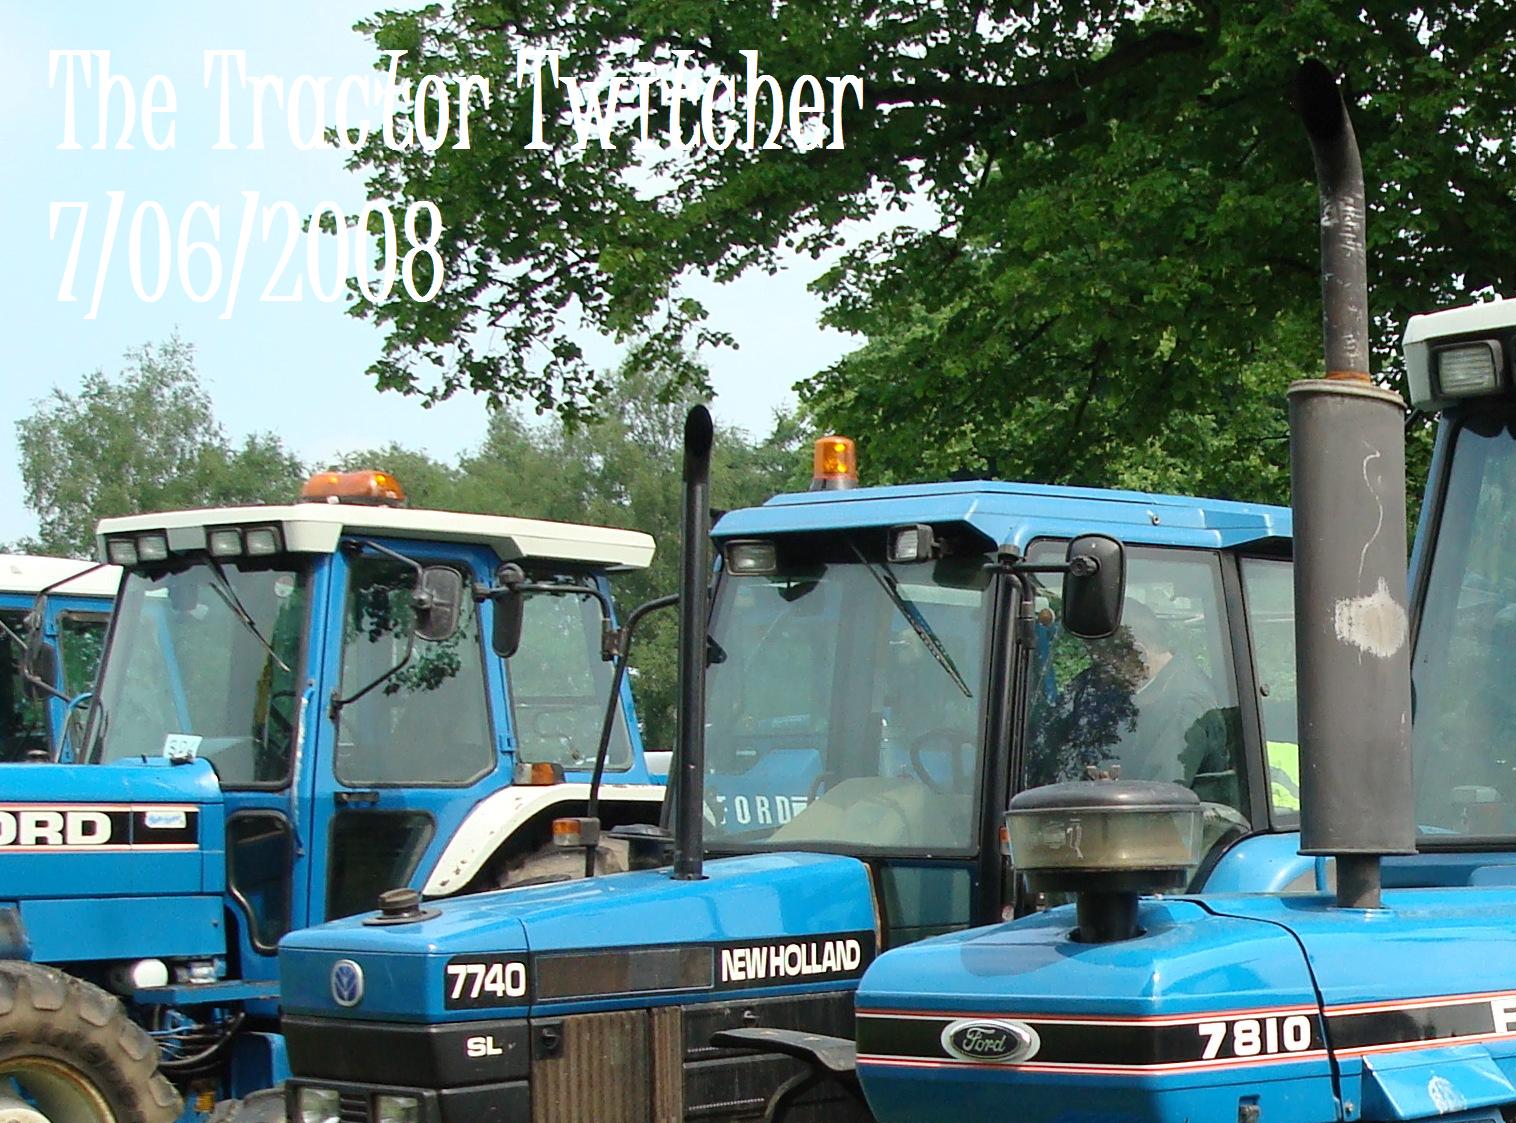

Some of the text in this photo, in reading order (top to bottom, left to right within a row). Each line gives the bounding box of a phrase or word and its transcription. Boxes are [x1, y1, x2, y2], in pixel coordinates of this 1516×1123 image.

[447, 962, 527, 1000] 7740
[466, 1036, 503, 1058] SL
[962, 1026, 1006, 1053] Ford
[1198, 1014, 1312, 1060] 7810
